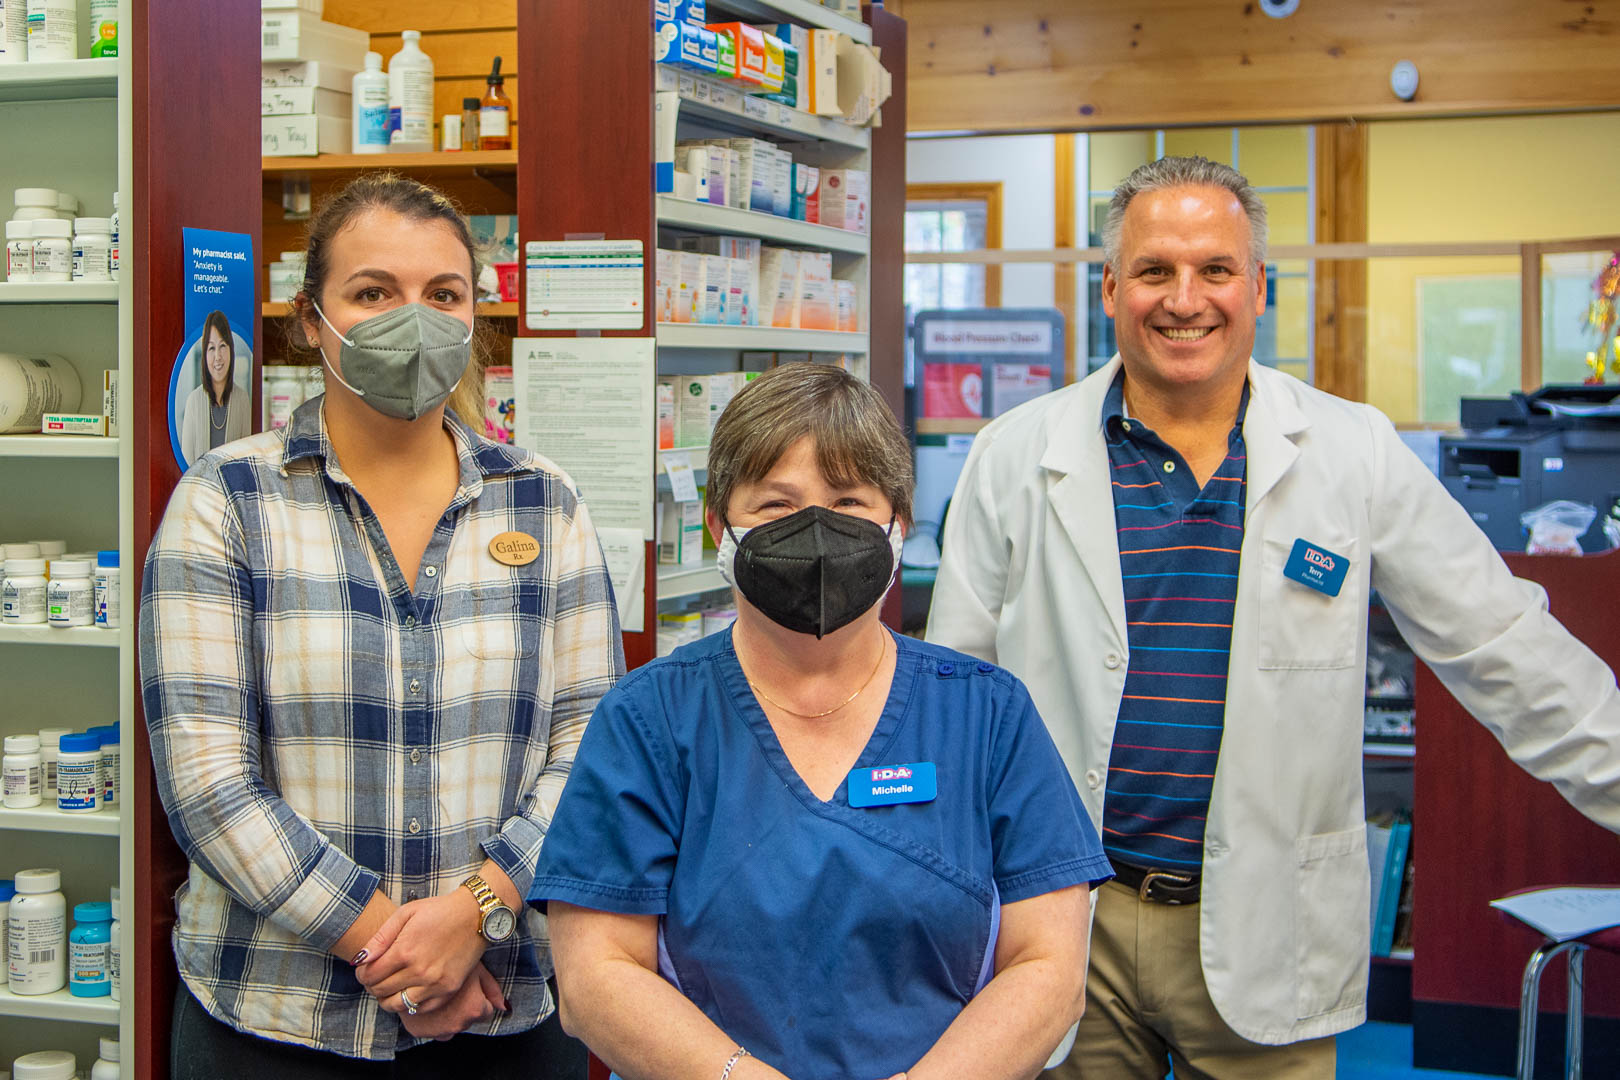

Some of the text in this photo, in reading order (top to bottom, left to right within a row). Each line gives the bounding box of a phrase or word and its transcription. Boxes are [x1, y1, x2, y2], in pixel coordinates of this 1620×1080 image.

[192, 247, 202, 258] My
[202, 249, 233, 259] pharmacist
[217, 262, 223, 271] is
[193, 273, 230, 284] manageable.
[193, 284, 208, 293] Let's
[495, 540, 536, 554] Galina
[1309, 566, 1324, 579] Terry
[871, 784, 914, 796] Michelle
